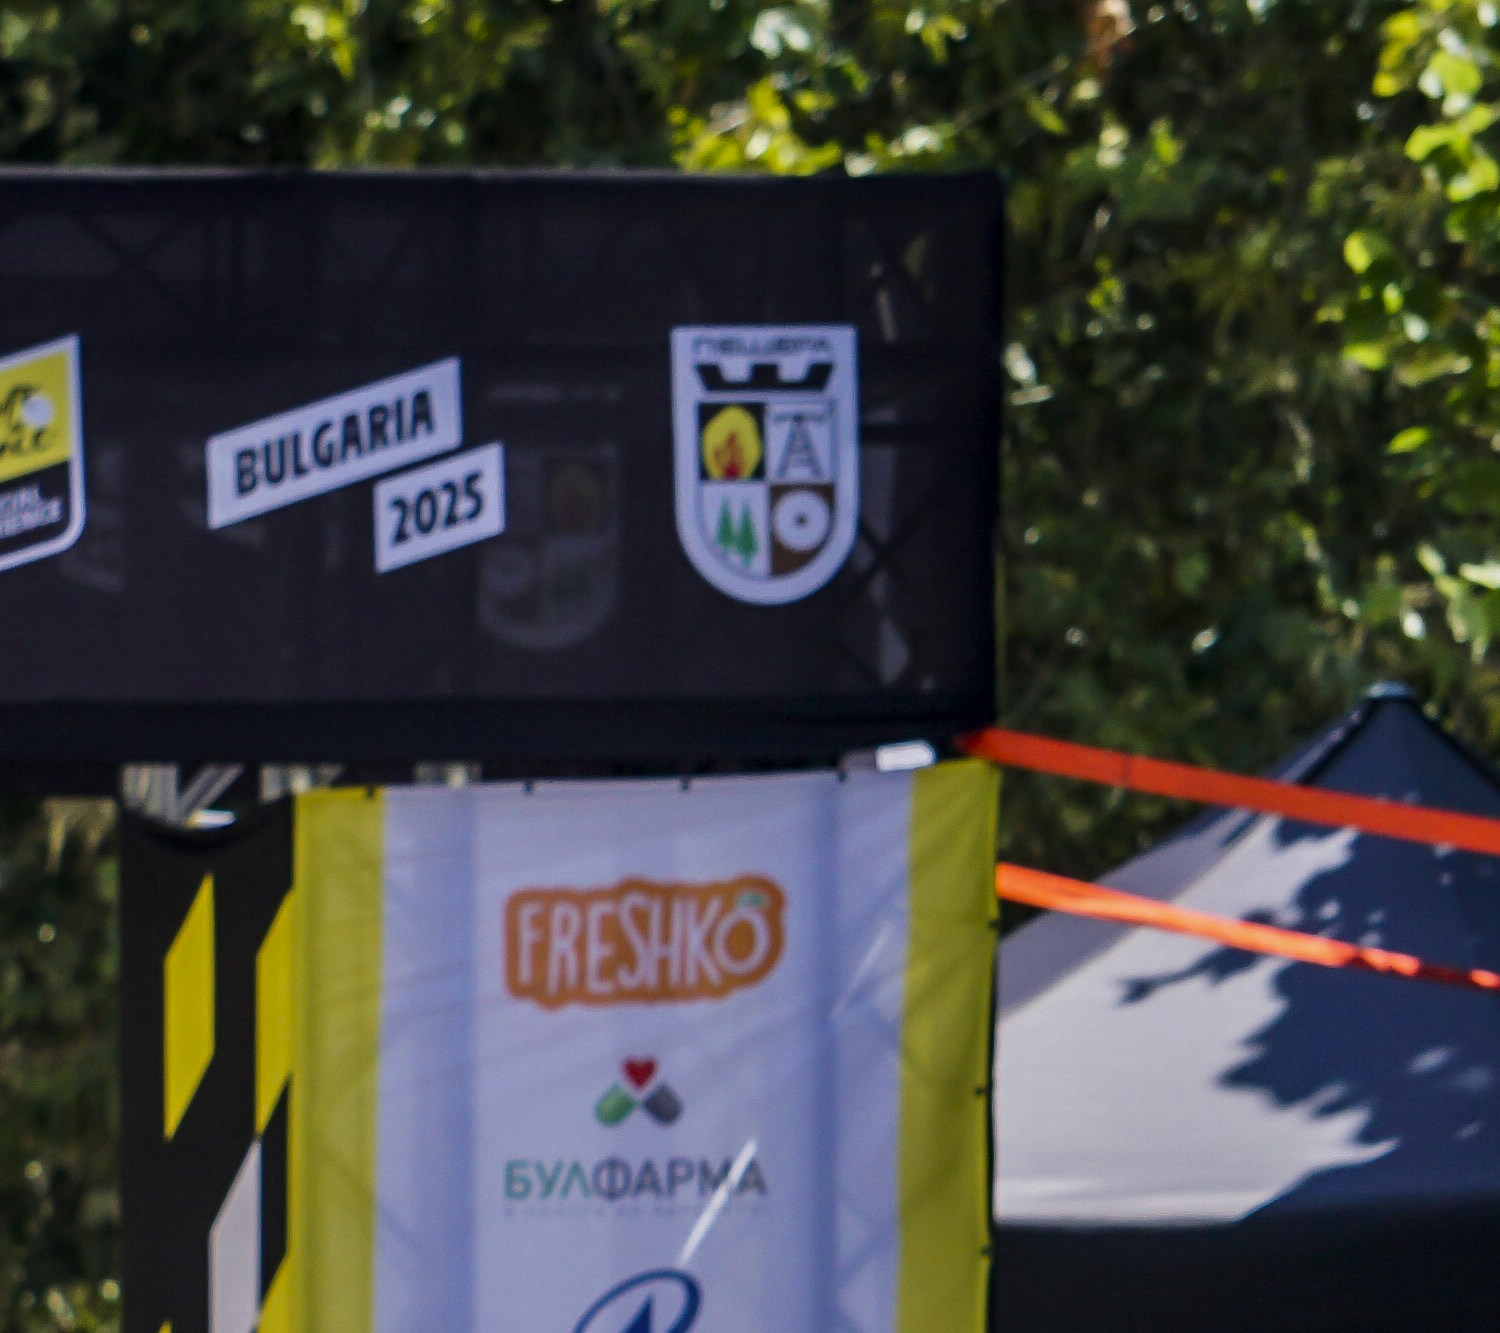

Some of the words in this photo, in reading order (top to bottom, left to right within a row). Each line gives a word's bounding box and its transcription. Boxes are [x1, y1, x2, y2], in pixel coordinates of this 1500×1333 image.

[235, 387, 437, 496] BULGARIA
[389, 470, 484, 549] 2025
[503, 1156, 768, 1202] БУЛФАРМА
